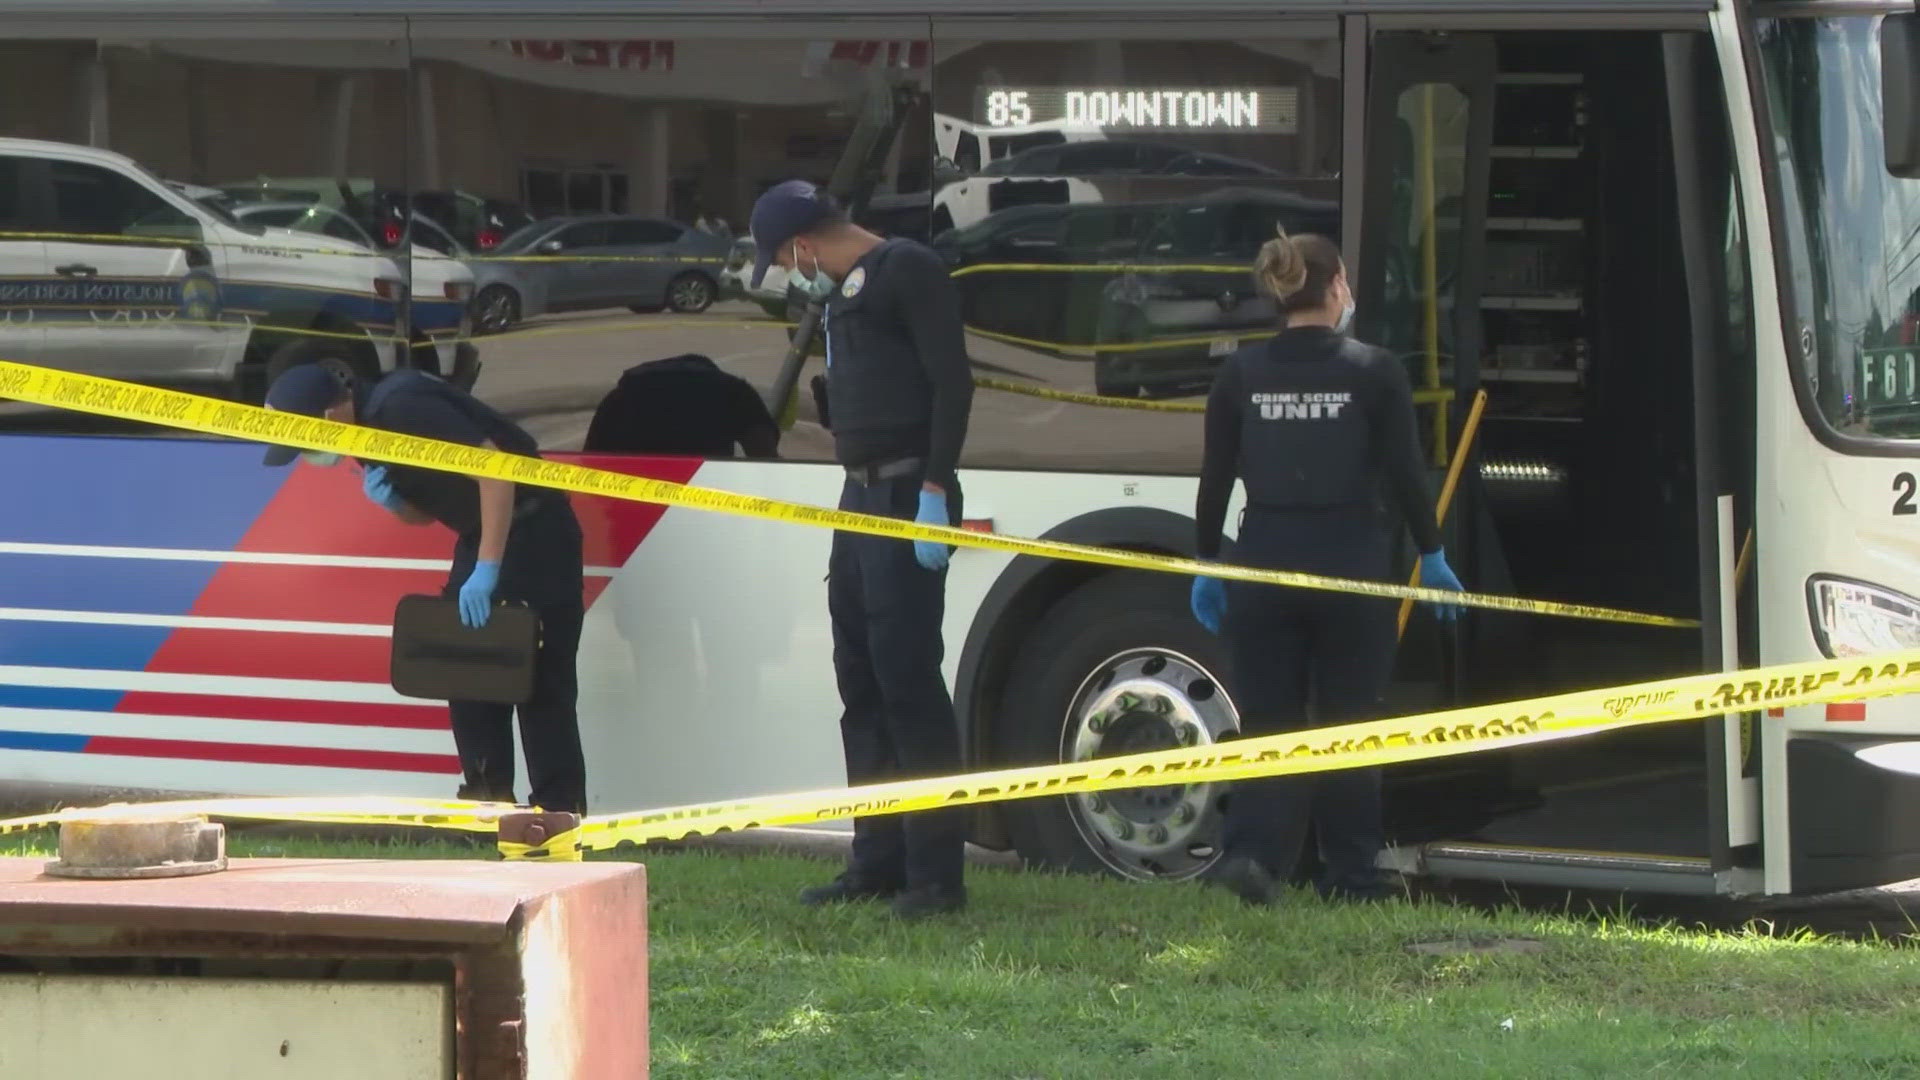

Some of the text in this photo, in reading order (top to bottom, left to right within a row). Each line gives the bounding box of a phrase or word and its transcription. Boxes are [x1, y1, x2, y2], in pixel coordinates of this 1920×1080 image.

[988, 91, 1258, 126] 85 DOWNTOWN
[1252, 392, 1352, 404] CRIME SCENE
[1261, 403, 1344, 419] UNIT
[1892, 472, 1917, 516] 2
